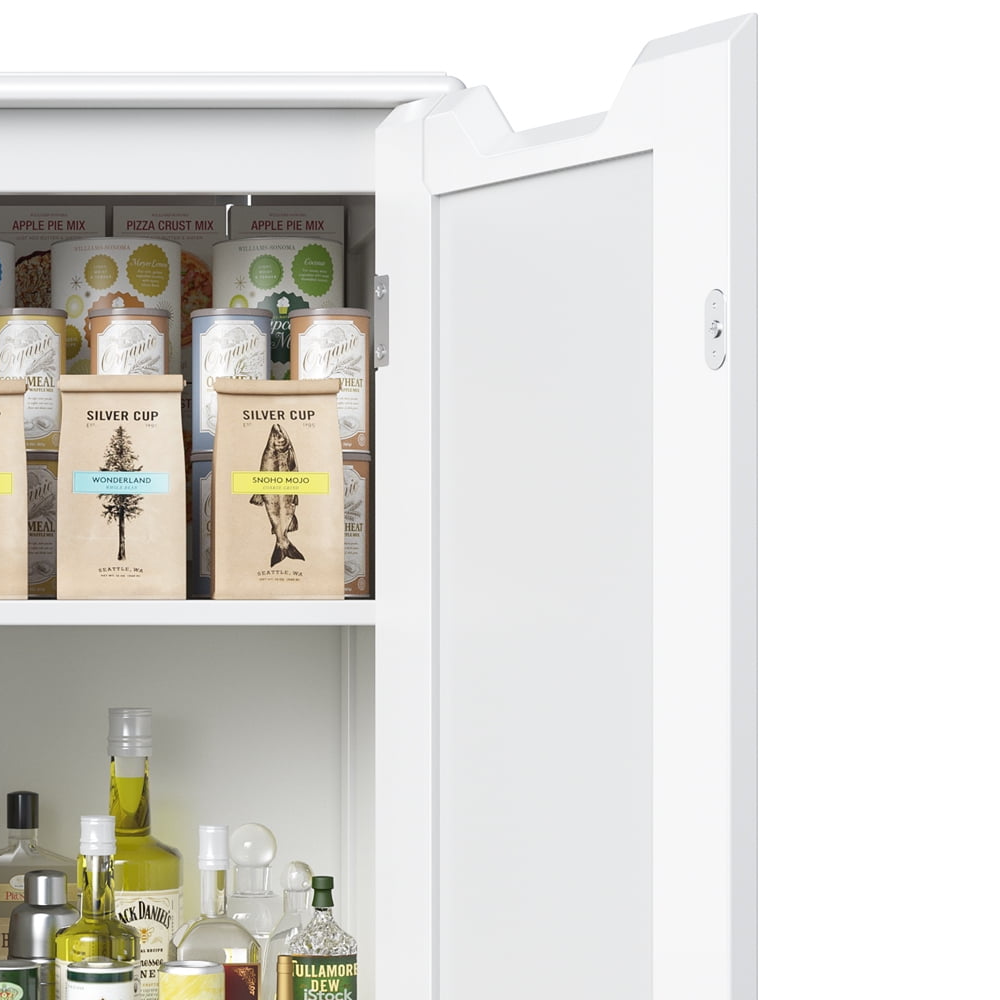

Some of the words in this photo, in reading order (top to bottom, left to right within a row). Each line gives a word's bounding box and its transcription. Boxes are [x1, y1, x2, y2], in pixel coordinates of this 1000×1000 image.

[12, 220, 45, 230] APPLE
[47, 220, 63, 230] PIE
[66, 220, 86, 230] MIX
[126, 220, 155, 230] PIZZA
[158, 220, 192, 230] CRUST
[195, 220, 214, 230] MIX
[251, 220, 284, 230] APPLE
[286, 220, 302, 230] PIE
[305, 220, 325, 230] MIX
[101, 334, 155, 373] Organic
[204, 334, 258, 373] Organic
[303, 334, 358, 373] Organic
[86, 410, 129, 421] SILVER
[133, 410, 159, 421] CUP
[242, 410, 285, 420] SILVER
[289, 410, 315, 420] CUP
[118, 906, 137, 924] ACK
[138, 900, 171, 930] DANIEL'S
[311, 979, 340, 992] DEW
